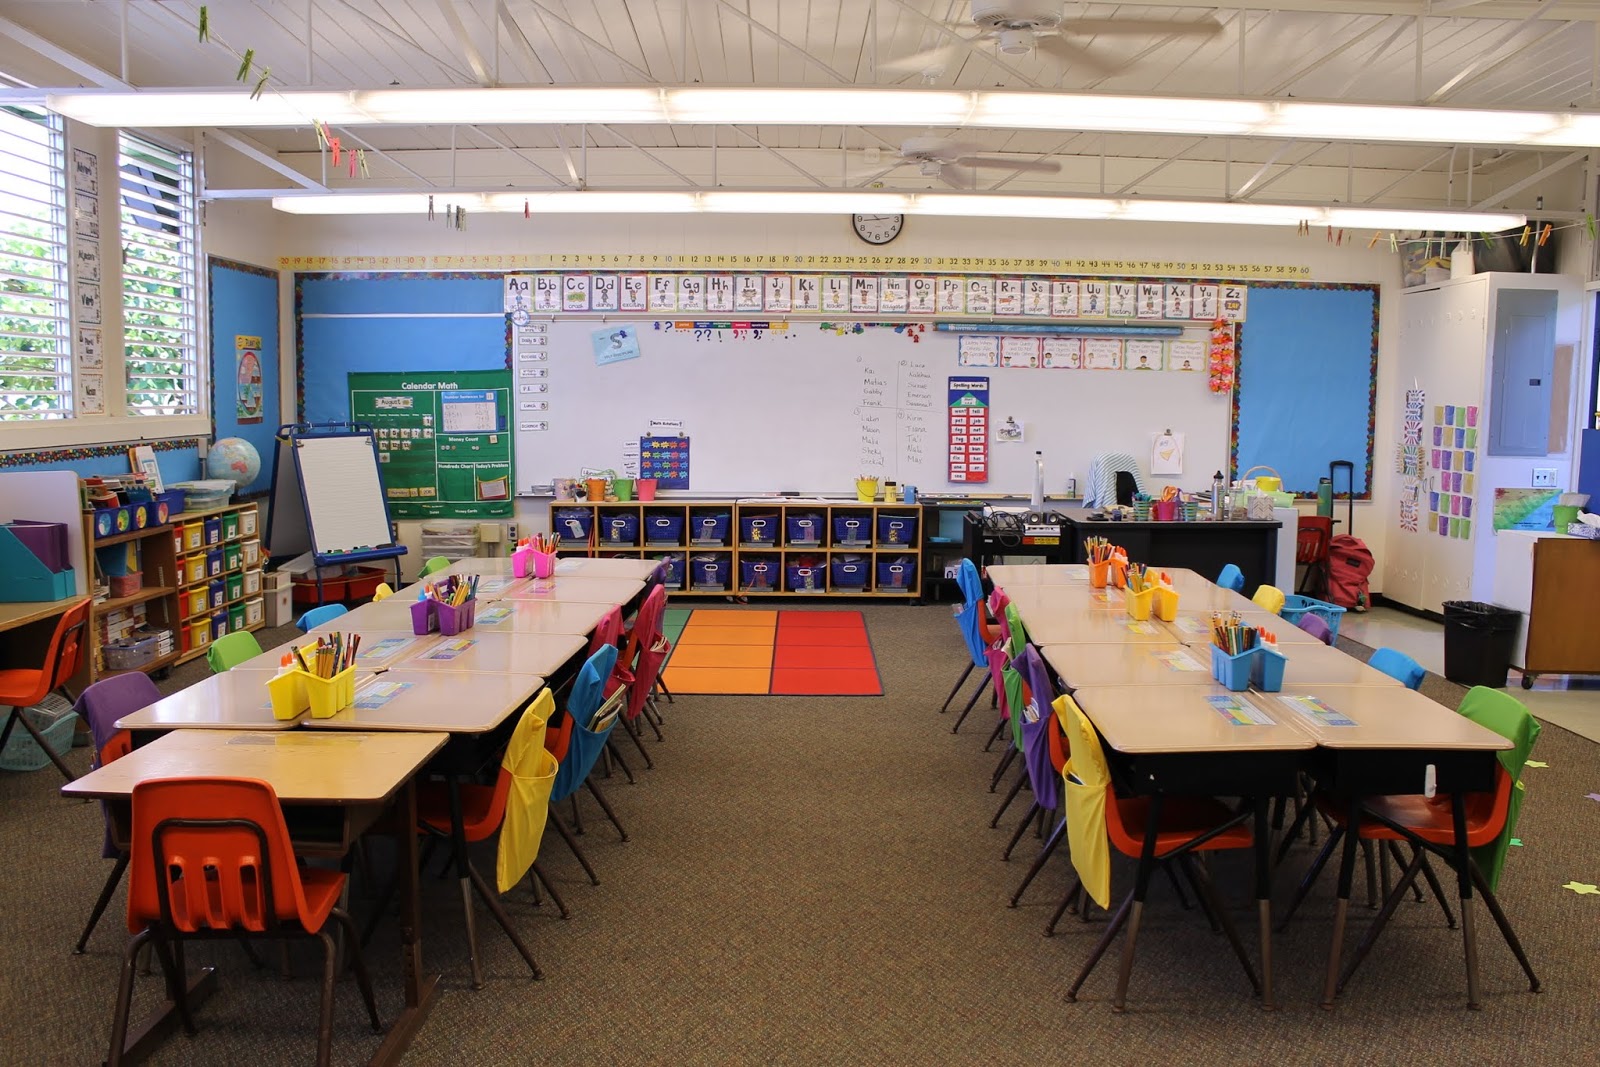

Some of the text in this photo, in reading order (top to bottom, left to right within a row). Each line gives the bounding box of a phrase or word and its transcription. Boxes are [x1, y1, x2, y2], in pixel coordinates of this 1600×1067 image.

[549, 255, 553, 263] 1
[561, 255, 568, 263] 2
[574, 254, 580, 263] 3
[586, 255, 593, 263] 4
[600, 255, 606, 263] 5
[613, 255, 619, 263] 6
[626, 255, 633, 263] 7
[639, 255, 645, 263] 8
[651, 255, 658, 263] 9
[665, 255, 673, 263] 10
[678, 255, 685, 263] 11
[691, 255, 699, 263] 12
[704, 255, 712, 263] 13
[717, 255, 725, 263] 14
[730, 255, 738, 263] 15
[743, 255, 751, 263] 16
[756, 255, 764, 263] 17
[769, 255, 776, 263] 18
[782, 255, 790, 263] 19
[794, 255, 804, 263] 20
[807, 255, 815, 263] 21
[819, 255, 829, 263] 22
[833, 256, 842, 264] 23
[845, 256, 855, 264] 24
[858, 256, 868, 264] 25
[871, 256, 881, 264] 26
[884, 256, 894, 264] 27
[897, 257, 906, 265] 28
[910, 257, 920, 265] 29
[923, 257, 933, 265] 30
[937, 257, 945, 265] 31
[949, 257, 958, 265] 32
[962, 257, 971, 266] 33
[974, 258, 984, 266] 34
[988, 258, 997, 266] 35
[1000, 258, 1010, 266] 36
[1013, 259, 1022, 267] 37
[1025, 259, 1035, 267] 38
[1039, 259, 1048, 267] 39
[1051, 260, 1061, 268] 40
[1076, 260, 1086, 268] 42
[1088, 260, 1098, 268] 43
[1101, 260, 1111, 268] 44
[1113, 261, 1123, 269] 45
[1126, 261, 1136, 269] 46
[1139, 261, 1149, 269] 47
[1151, 262, 1161, 270] 48
[1176, 262, 1186, 270] 50
[1190, 263, 1198, 271] 51
[1202, 263, 1212, 271] 52
[1214, 263, 1224, 271] 53
[1227, 264, 1236, 272] 54
[1239, 264, 1248, 272] 55
[1251, 265, 1261, 273] 56
[1264, 265, 1273, 273] 57
[1276, 265, 1285, 273] 58
[1288, 266, 1297, 274] 59
[610, 332, 622, 350] S
[402, 382, 458, 390] Calendar Math
